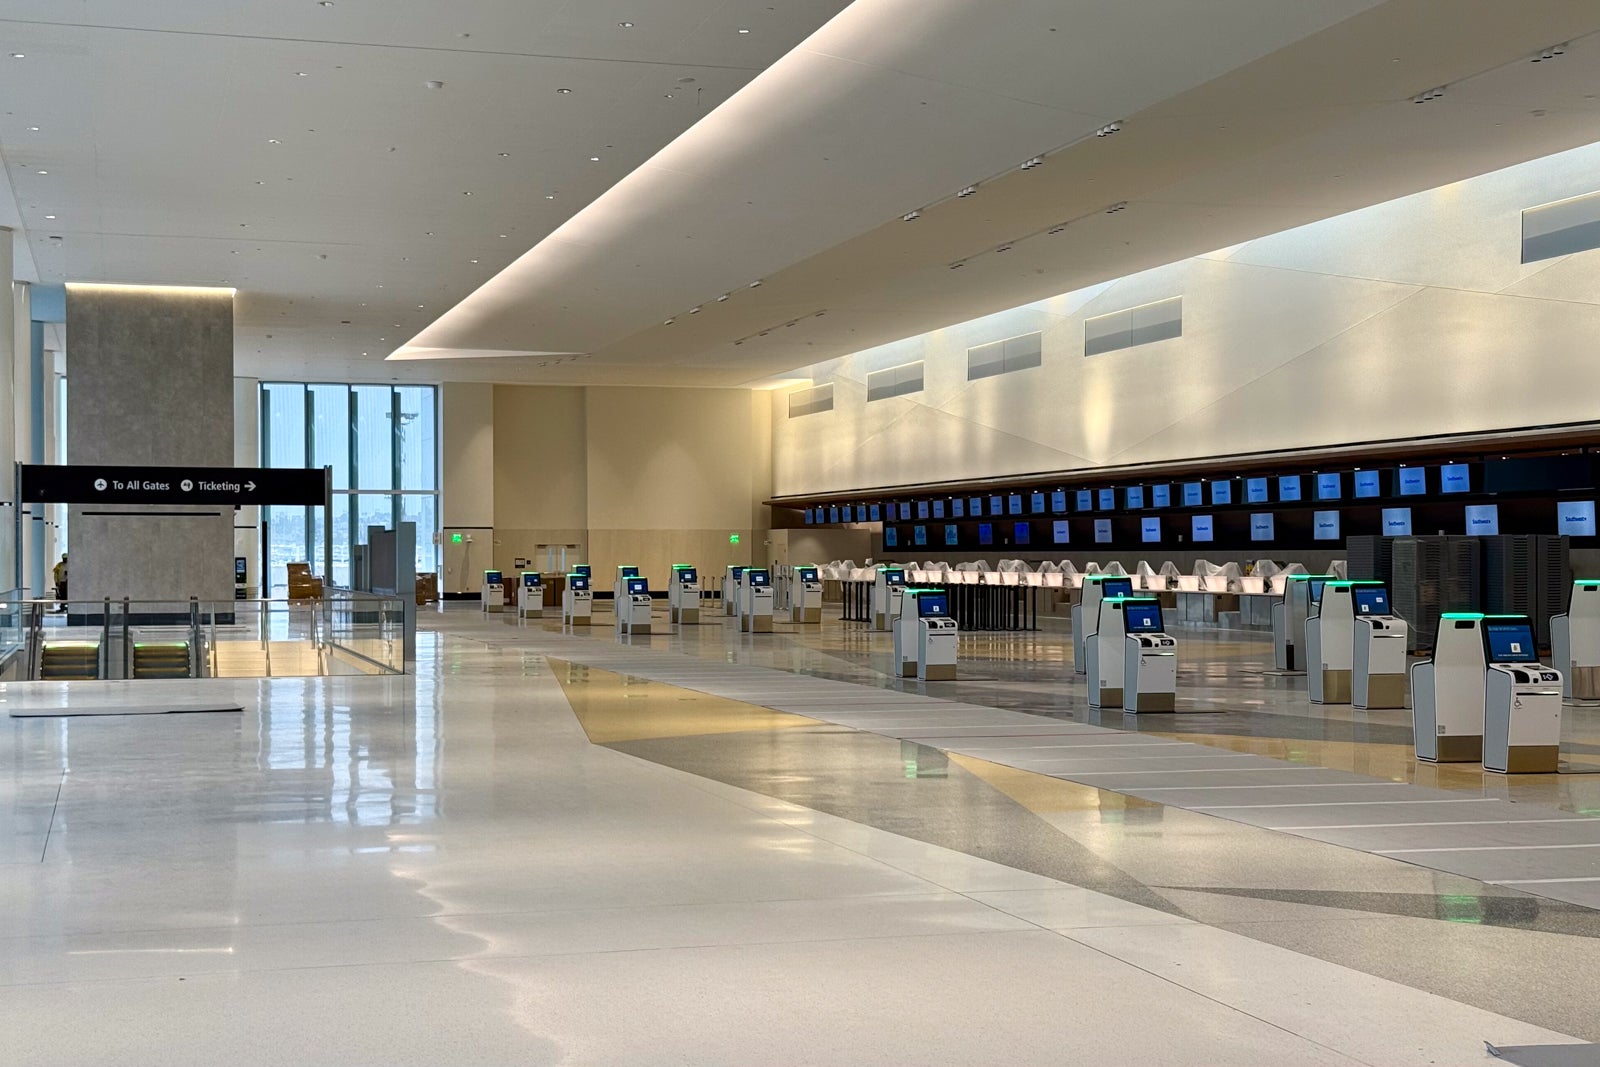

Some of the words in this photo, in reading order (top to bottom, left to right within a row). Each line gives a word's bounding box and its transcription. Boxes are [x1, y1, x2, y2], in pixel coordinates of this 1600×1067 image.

[112, 480, 124, 490] To
[126, 480, 140, 490] All
[142, 480, 170, 491] Gates
[198, 481, 240, 493] Ticketing
